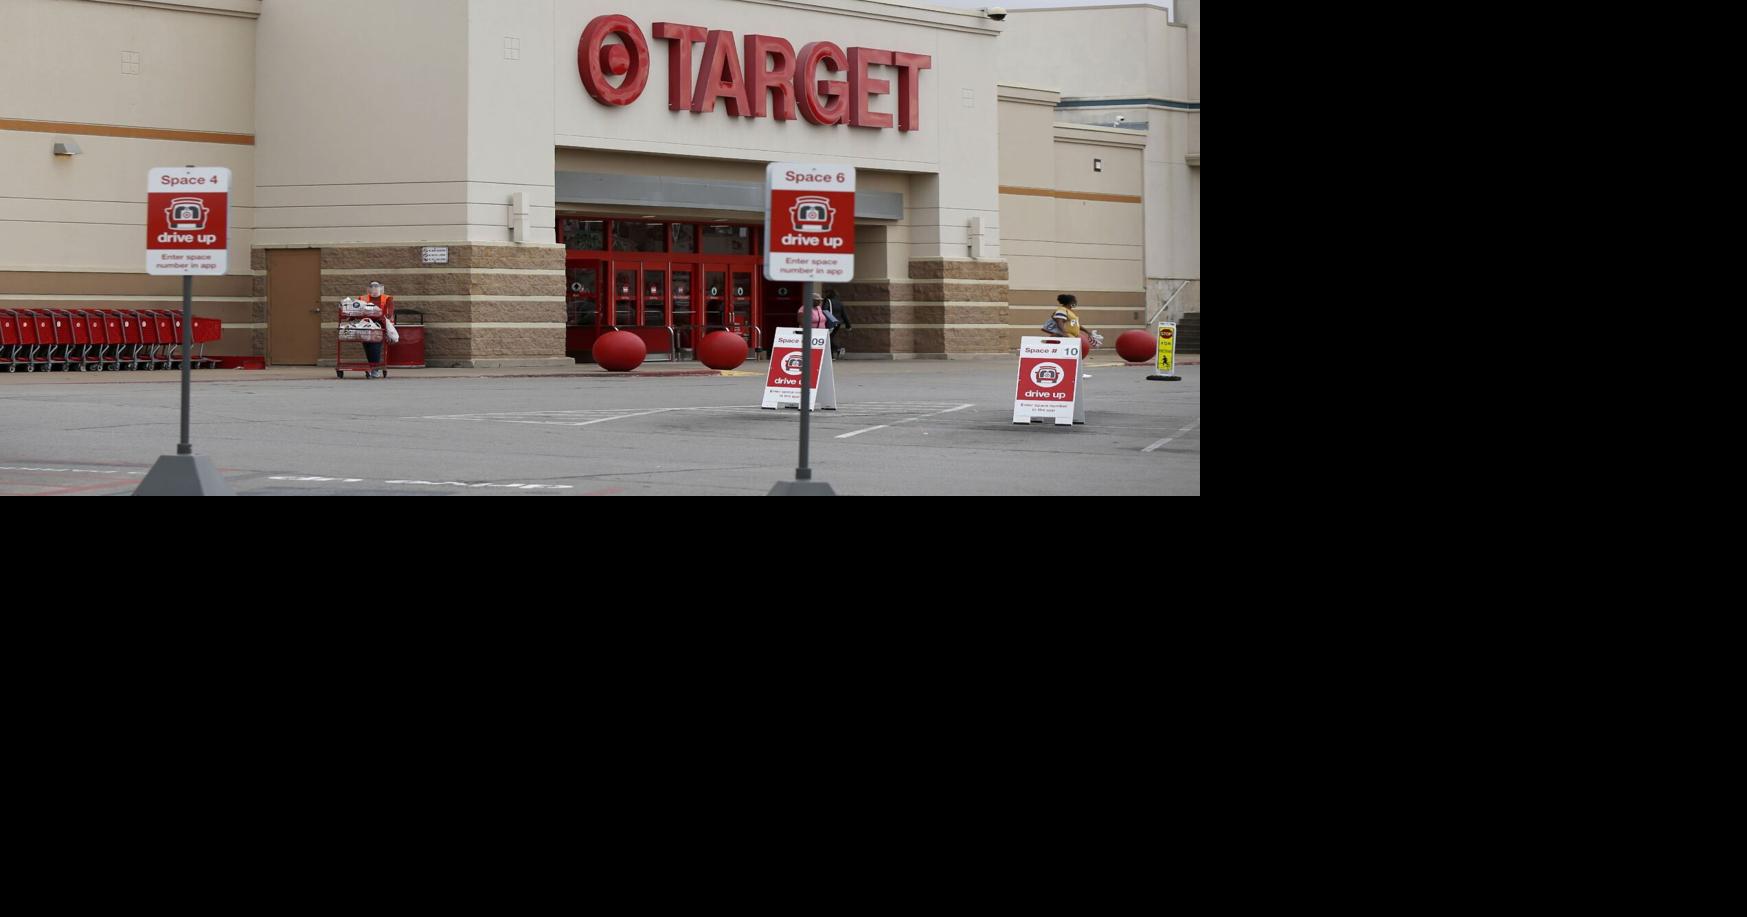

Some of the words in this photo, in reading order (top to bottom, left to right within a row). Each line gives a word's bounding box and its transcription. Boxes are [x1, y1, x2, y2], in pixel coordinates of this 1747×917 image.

[652, 22, 932, 132] TARGET
[161, 175, 205, 187] Space
[210, 175, 218, 184] 4
[785, 170, 832, 184] Space
[836, 172, 845, 183] 6
[157, 232, 194, 243] drive
[197, 233, 216, 245] up
[781, 233, 820, 246] drive
[823, 236, 844, 249] up
[186, 254, 211, 262] space
[785, 257, 809, 265] Enter
[811, 258, 838, 266] space
[811, 338, 825, 346] 09
[1064, 347, 1079, 356] 10
[774, 377, 797, 385] drive
[1024, 390, 1051, 398] drive
